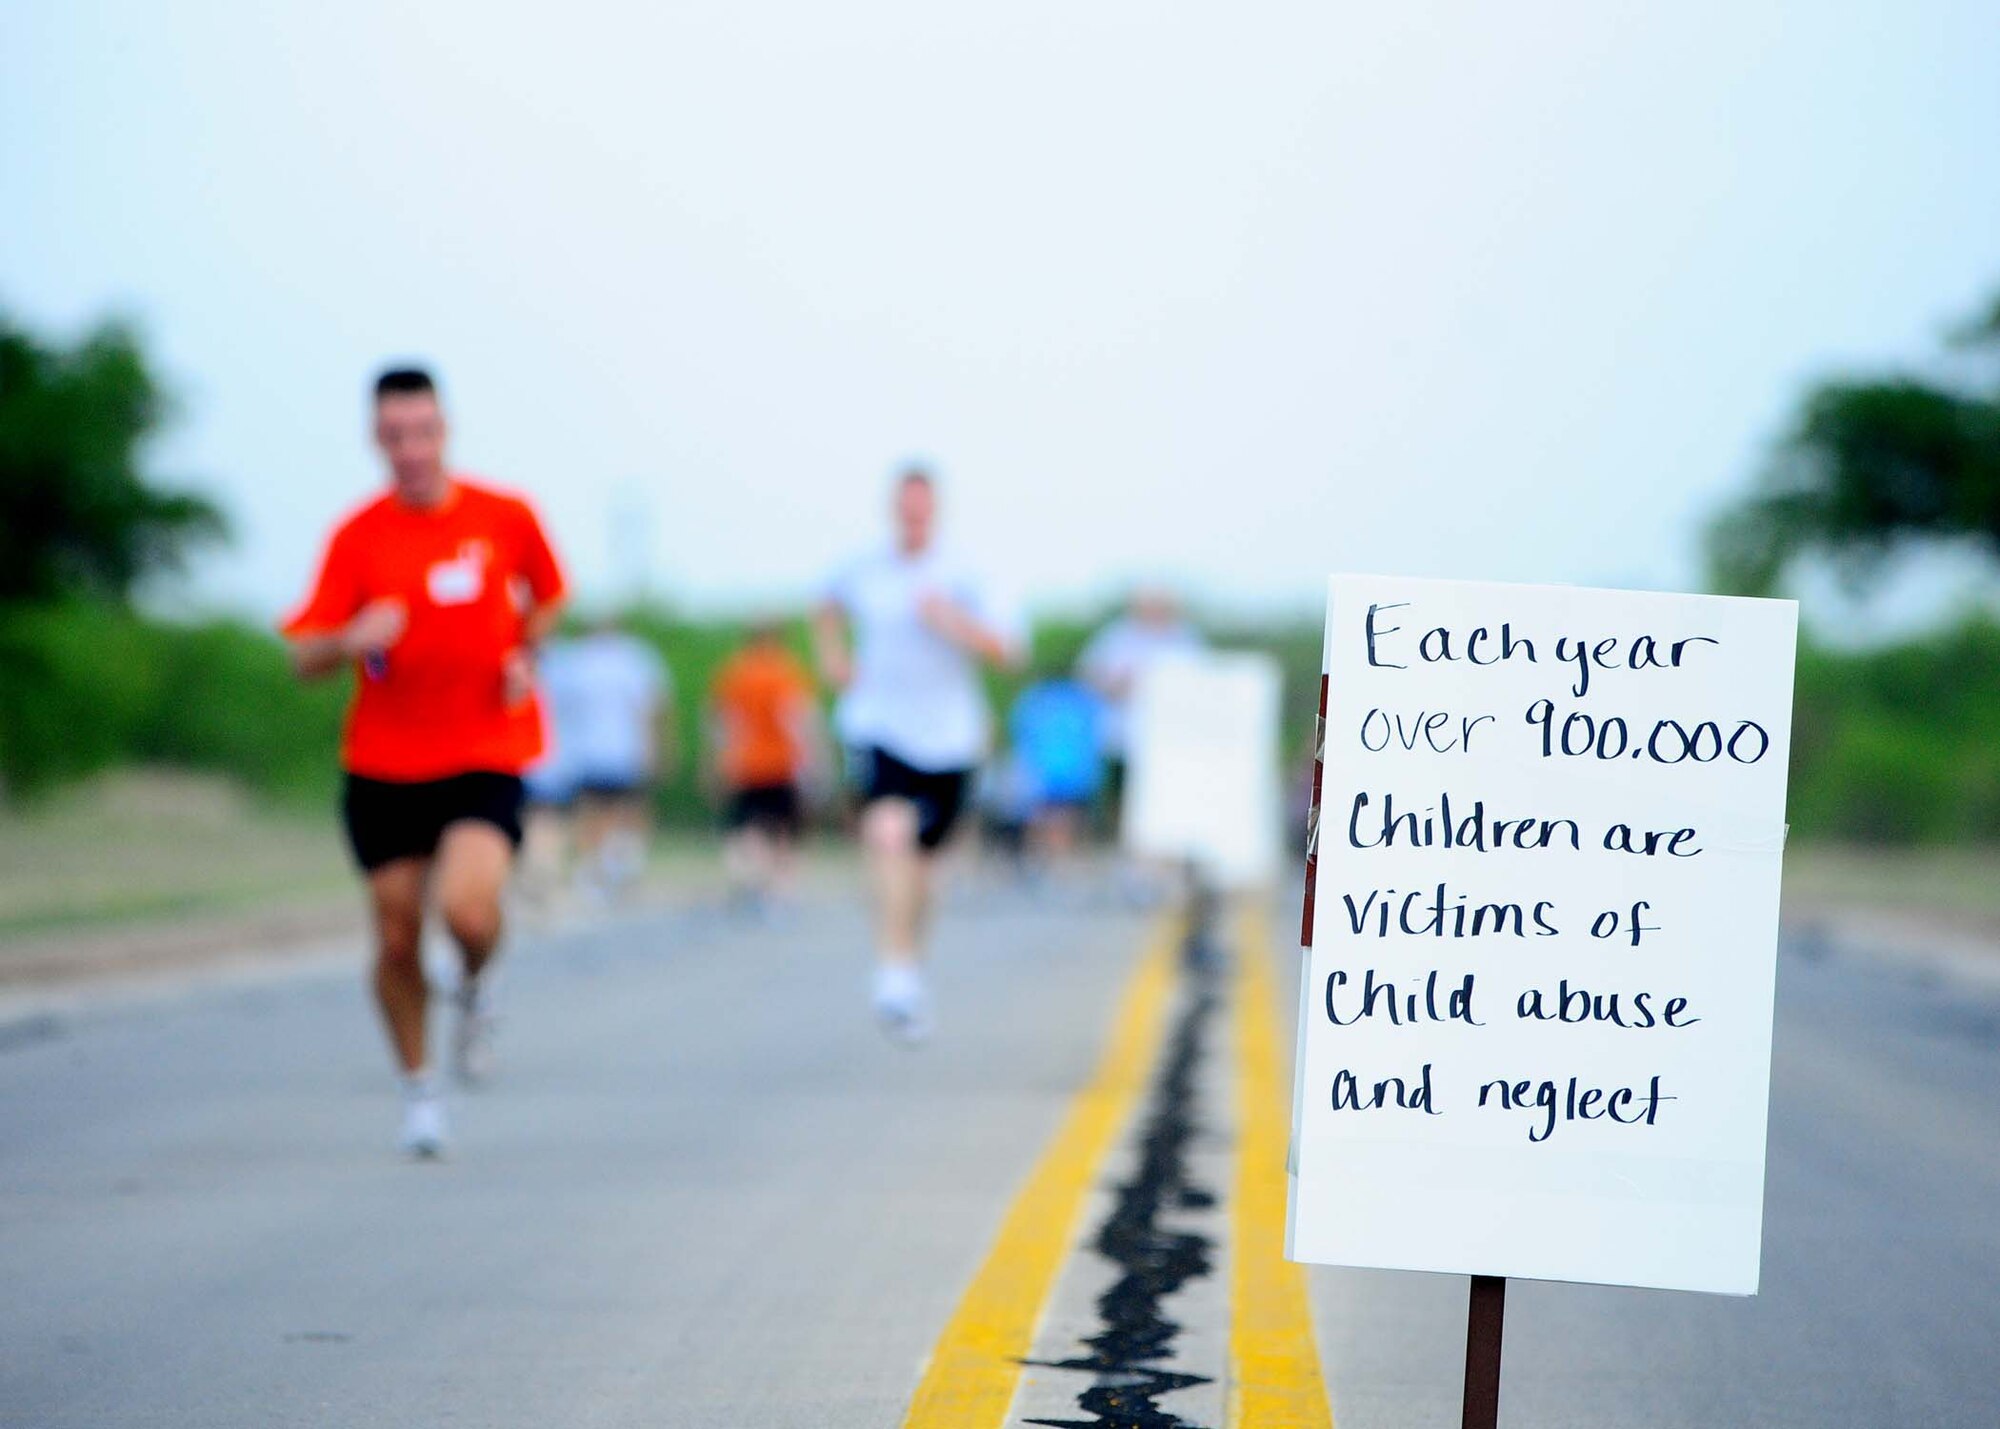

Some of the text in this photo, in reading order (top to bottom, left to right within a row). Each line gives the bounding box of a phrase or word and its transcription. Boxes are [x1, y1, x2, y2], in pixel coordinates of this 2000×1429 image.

[1366, 603, 1720, 698] Each year
[1360, 708, 1495, 753] over
[1348, 792, 1704, 858] Children are
[1590, 901, 1662, 947] of
[1325, 969, 1702, 1029] Child abuse
[1331, 1063, 1678, 1143] and neglect
